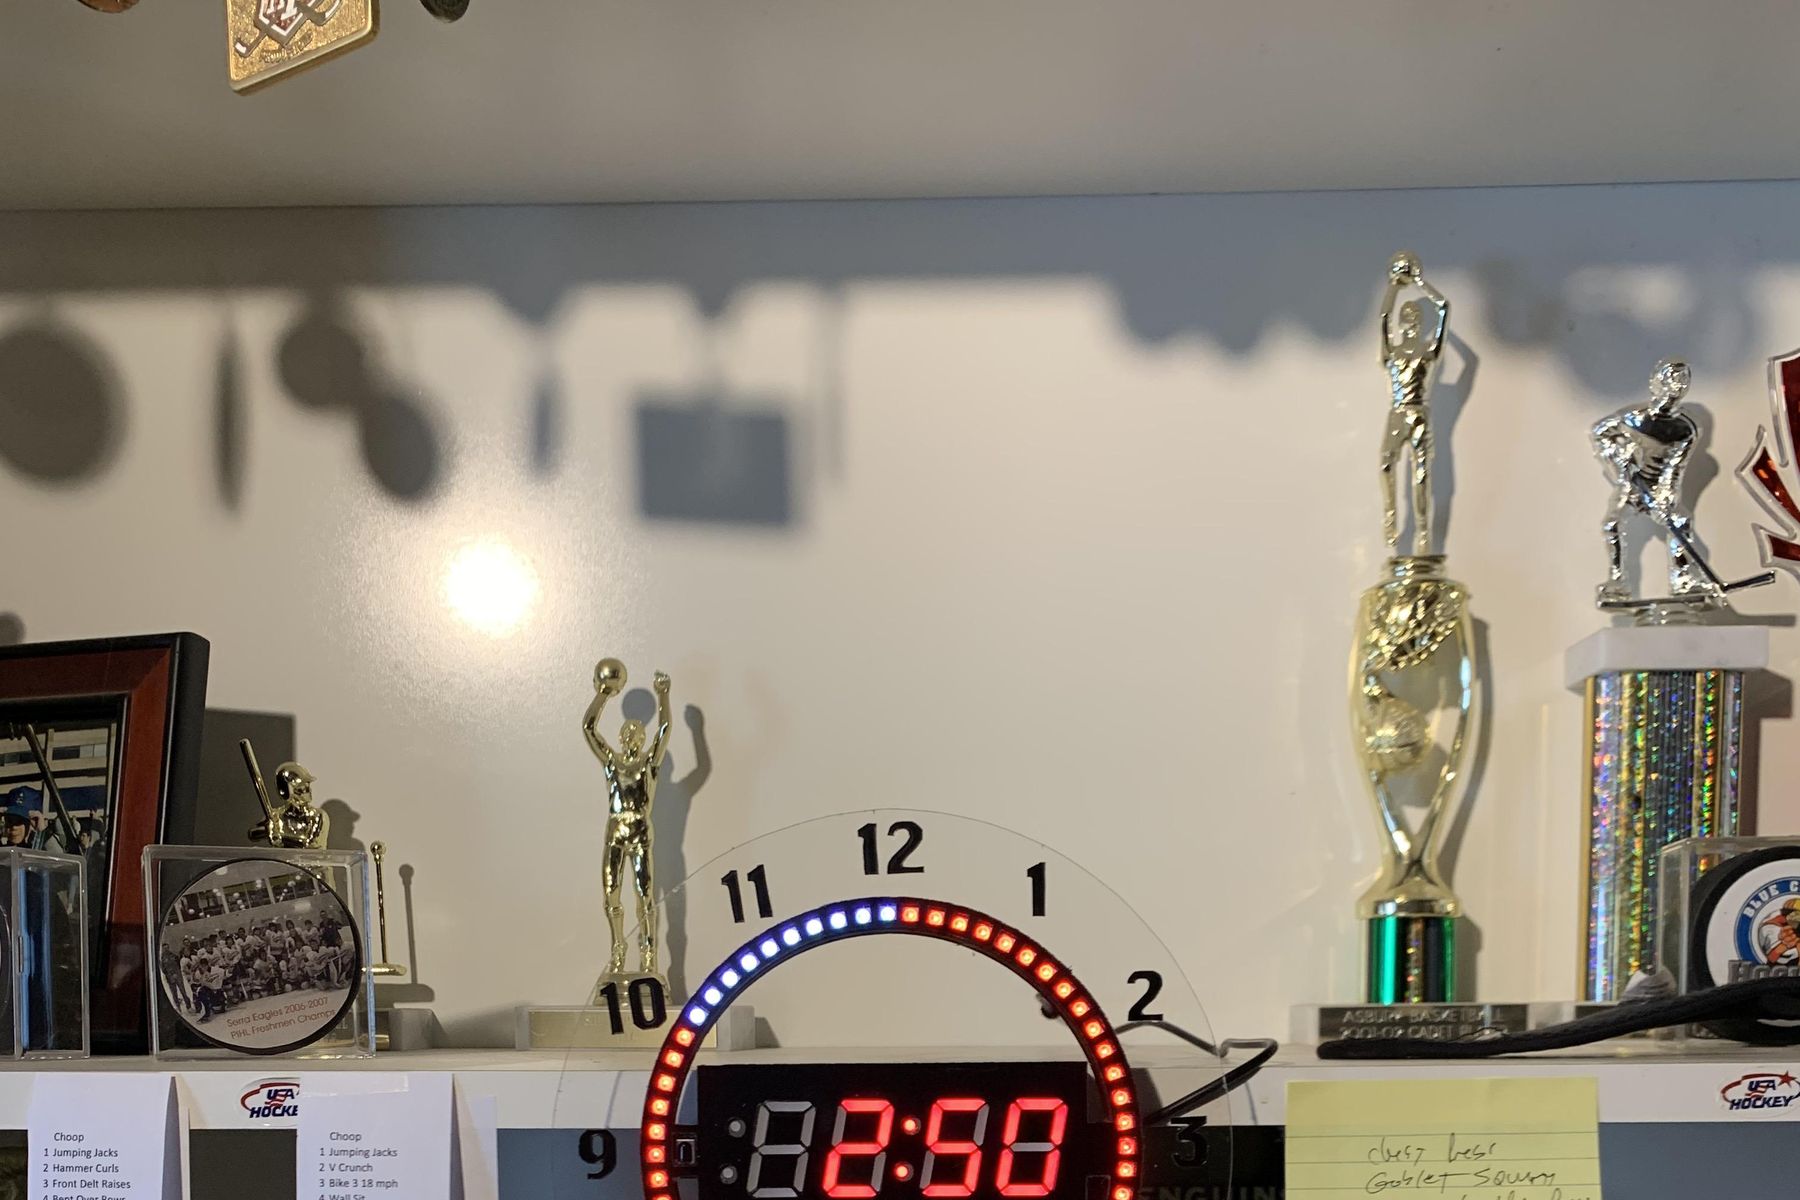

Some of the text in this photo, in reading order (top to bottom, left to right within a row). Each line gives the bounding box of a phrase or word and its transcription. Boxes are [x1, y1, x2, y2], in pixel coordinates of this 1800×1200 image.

[857, 820, 925, 875] 12
[721, 864, 772, 923] 11
[1027, 862, 1047, 917] 1
[1743, 884, 1779, 918] BLUE
[1127, 970, 1164, 1020] 2
[601, 977, 666, 1034] 10
[252, 1007, 283, 1022] Eagles
[1748, 1079, 1777, 1093] USA
[267, 1089, 295, 1100] USA
[1729, 1095, 1793, 1111] HOCKEY
[249, 1105, 298, 1118] HOCKE
[54, 1132, 84, 1143] Choop
[330, 1132, 362, 1142] Choop
[1169, 1116, 1208, 1166] 3
[44, 1148, 118, 1159] 1 Jumping Jacks
[579, 1129, 616, 1178] 9
[43, 1164, 119, 1173] 2 Hammer Curls
[319, 1163, 373, 1172] 2 V Crunch
[43, 1179, 131, 1189] 3 Front Delt Raises
[319, 1178, 398, 1190] 3 Bike 3 18 mph
